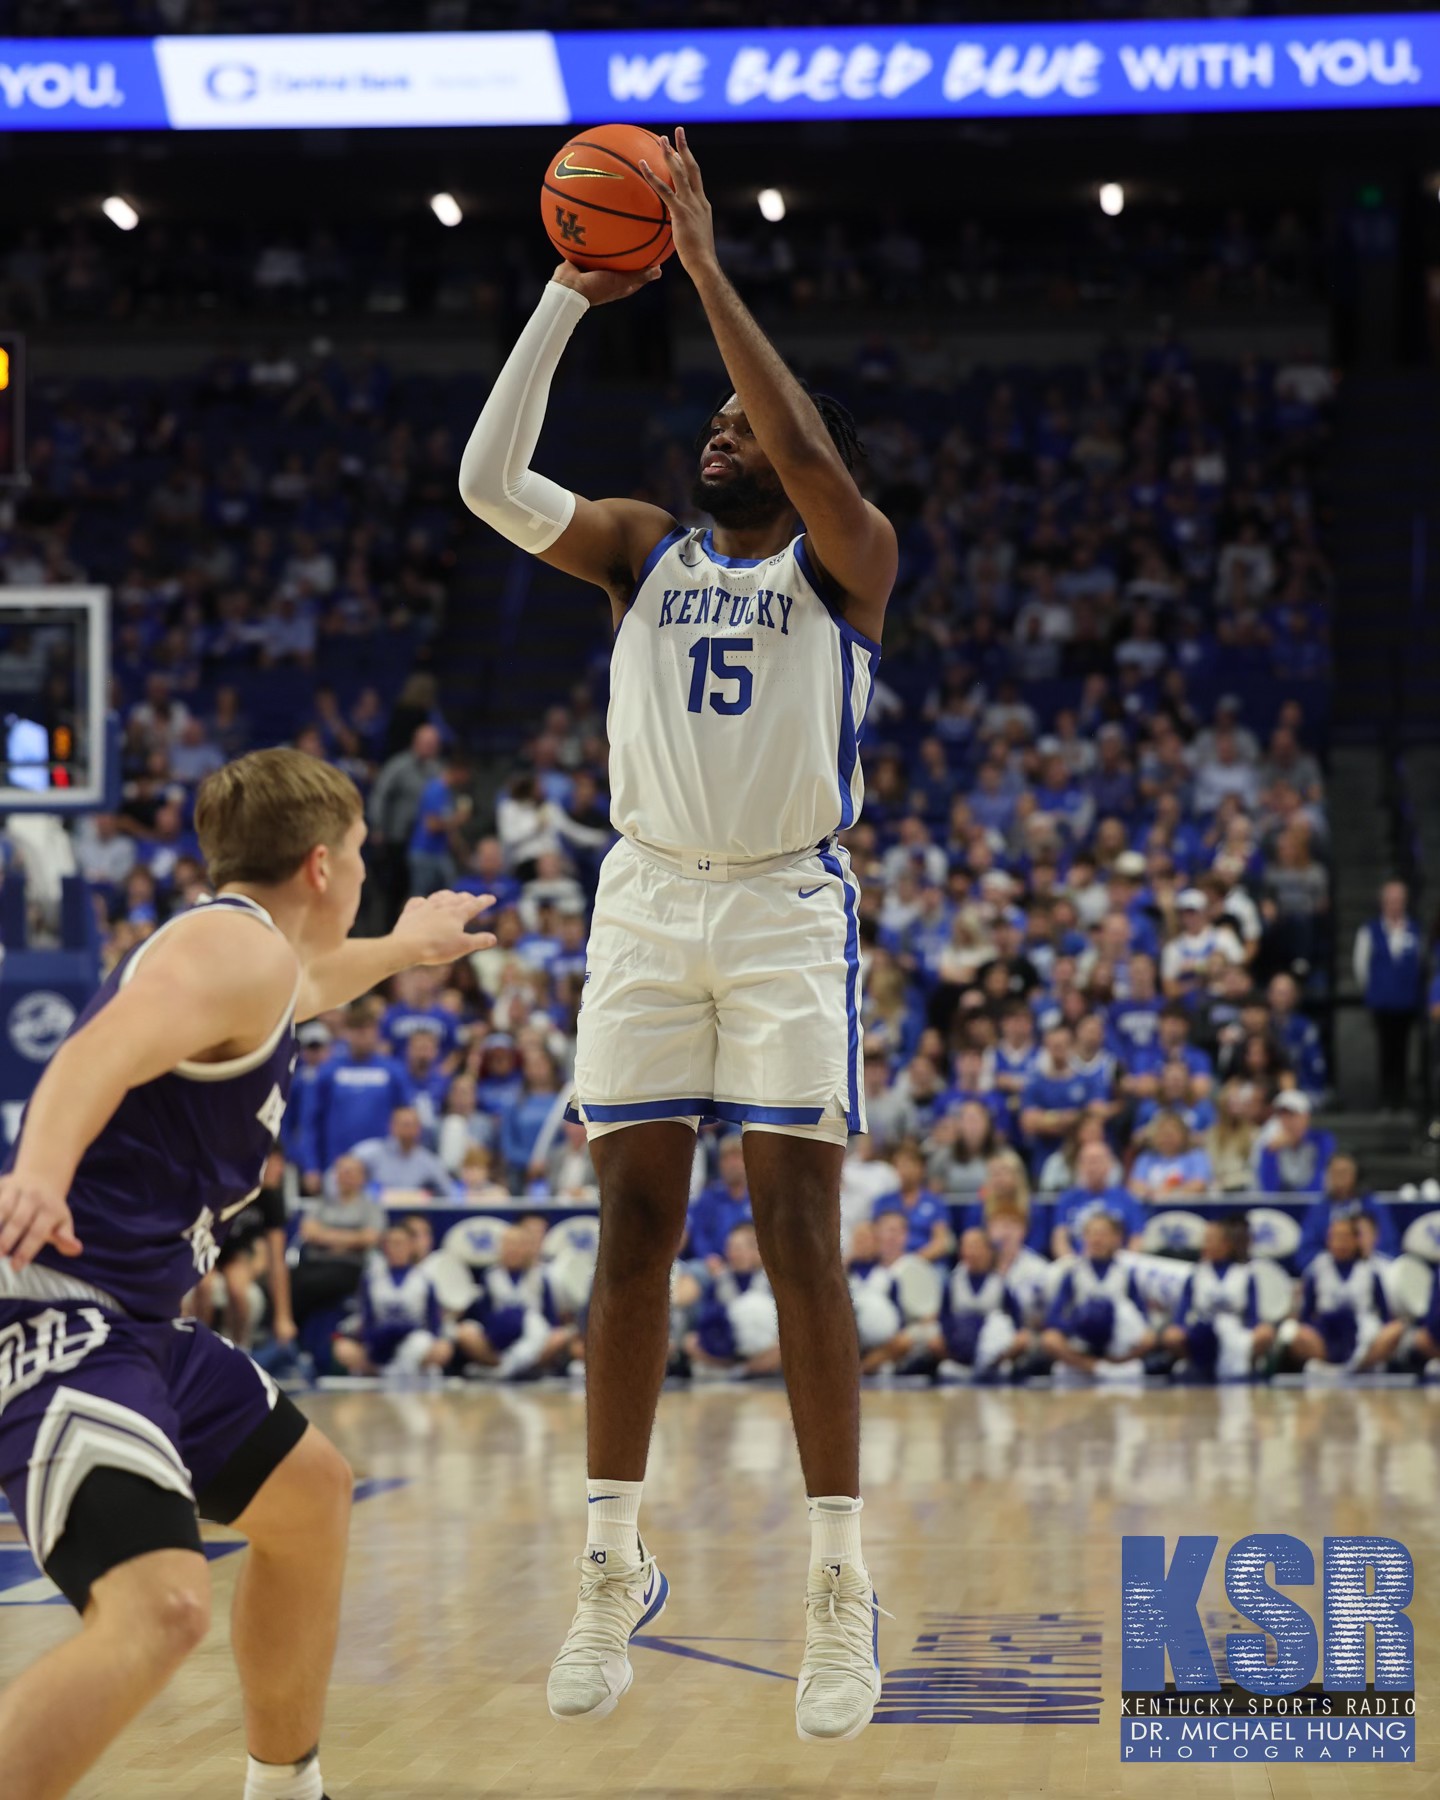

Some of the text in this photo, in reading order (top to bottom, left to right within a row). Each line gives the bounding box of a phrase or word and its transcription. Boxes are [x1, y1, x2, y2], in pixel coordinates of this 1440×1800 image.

[607, 38, 1421, 105] WE BLEED BLUE WITH YOU.
[555, 205, 587, 246] UK
[658, 585, 793, 635] KENTUCKY
[687, 636, 753, 716] 15
